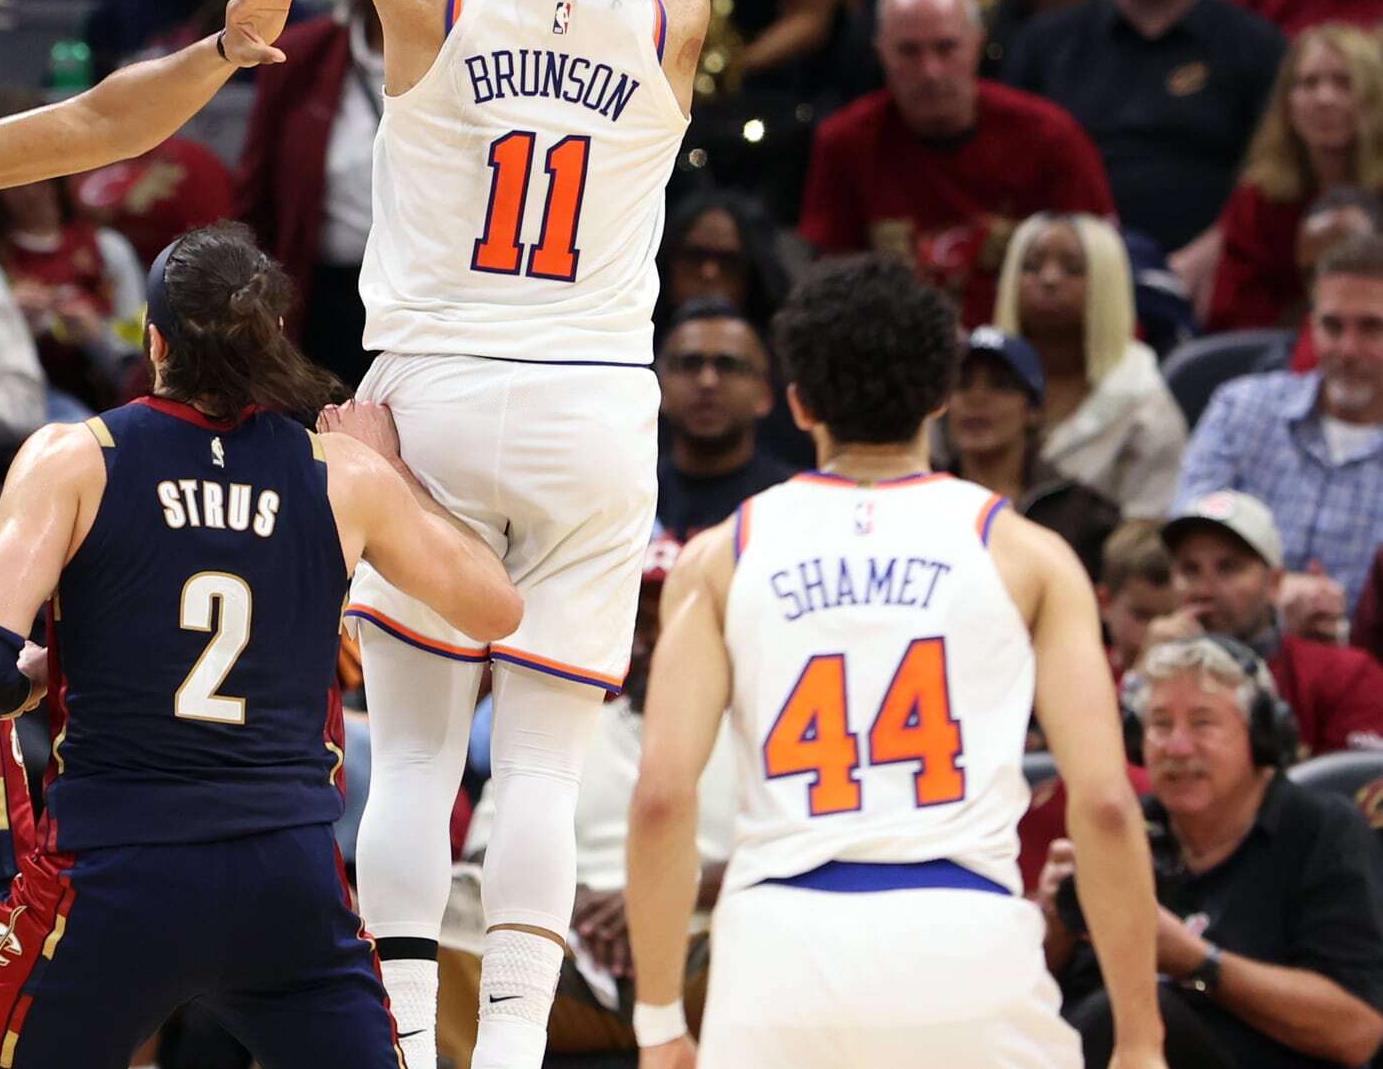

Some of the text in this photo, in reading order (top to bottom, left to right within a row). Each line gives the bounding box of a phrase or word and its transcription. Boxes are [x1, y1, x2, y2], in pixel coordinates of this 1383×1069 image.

[465, 49, 640, 122] BRUNSON
[470, 130, 591, 283] 11
[157, 479, 280, 538] STRUS
[770, 558, 951, 621] SHAMET
[174, 570, 253, 725] 2
[763, 635, 966, 817] 44
